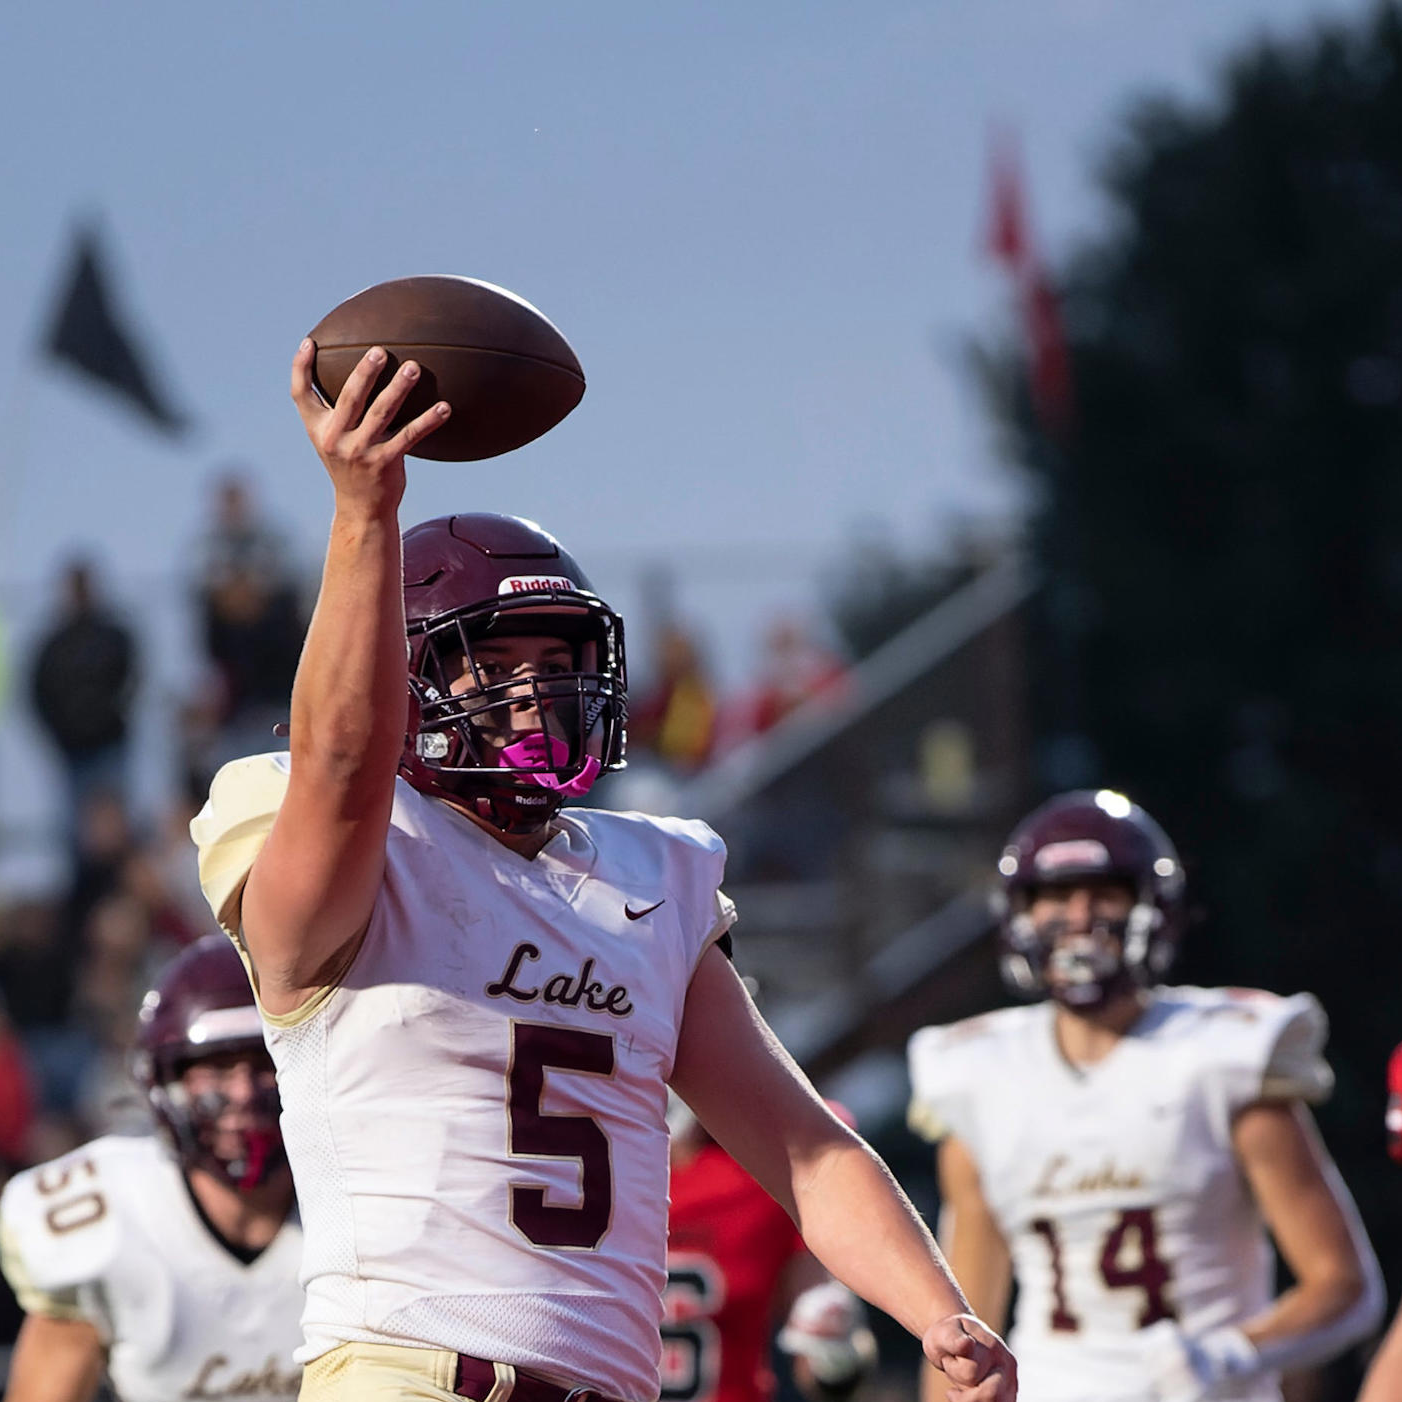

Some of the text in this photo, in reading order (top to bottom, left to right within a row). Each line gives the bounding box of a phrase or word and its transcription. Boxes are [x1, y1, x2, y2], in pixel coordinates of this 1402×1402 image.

[510, 579, 572, 592] Riddell
[515, 795, 547, 805] Riddell
[484, 940, 634, 1018] Lake
[504, 1017, 617, 1251] 5
[35, 1157, 108, 1236] 50
[1030, 1154, 1143, 1197] Lake
[1030, 1207, 1180, 1332] 14
